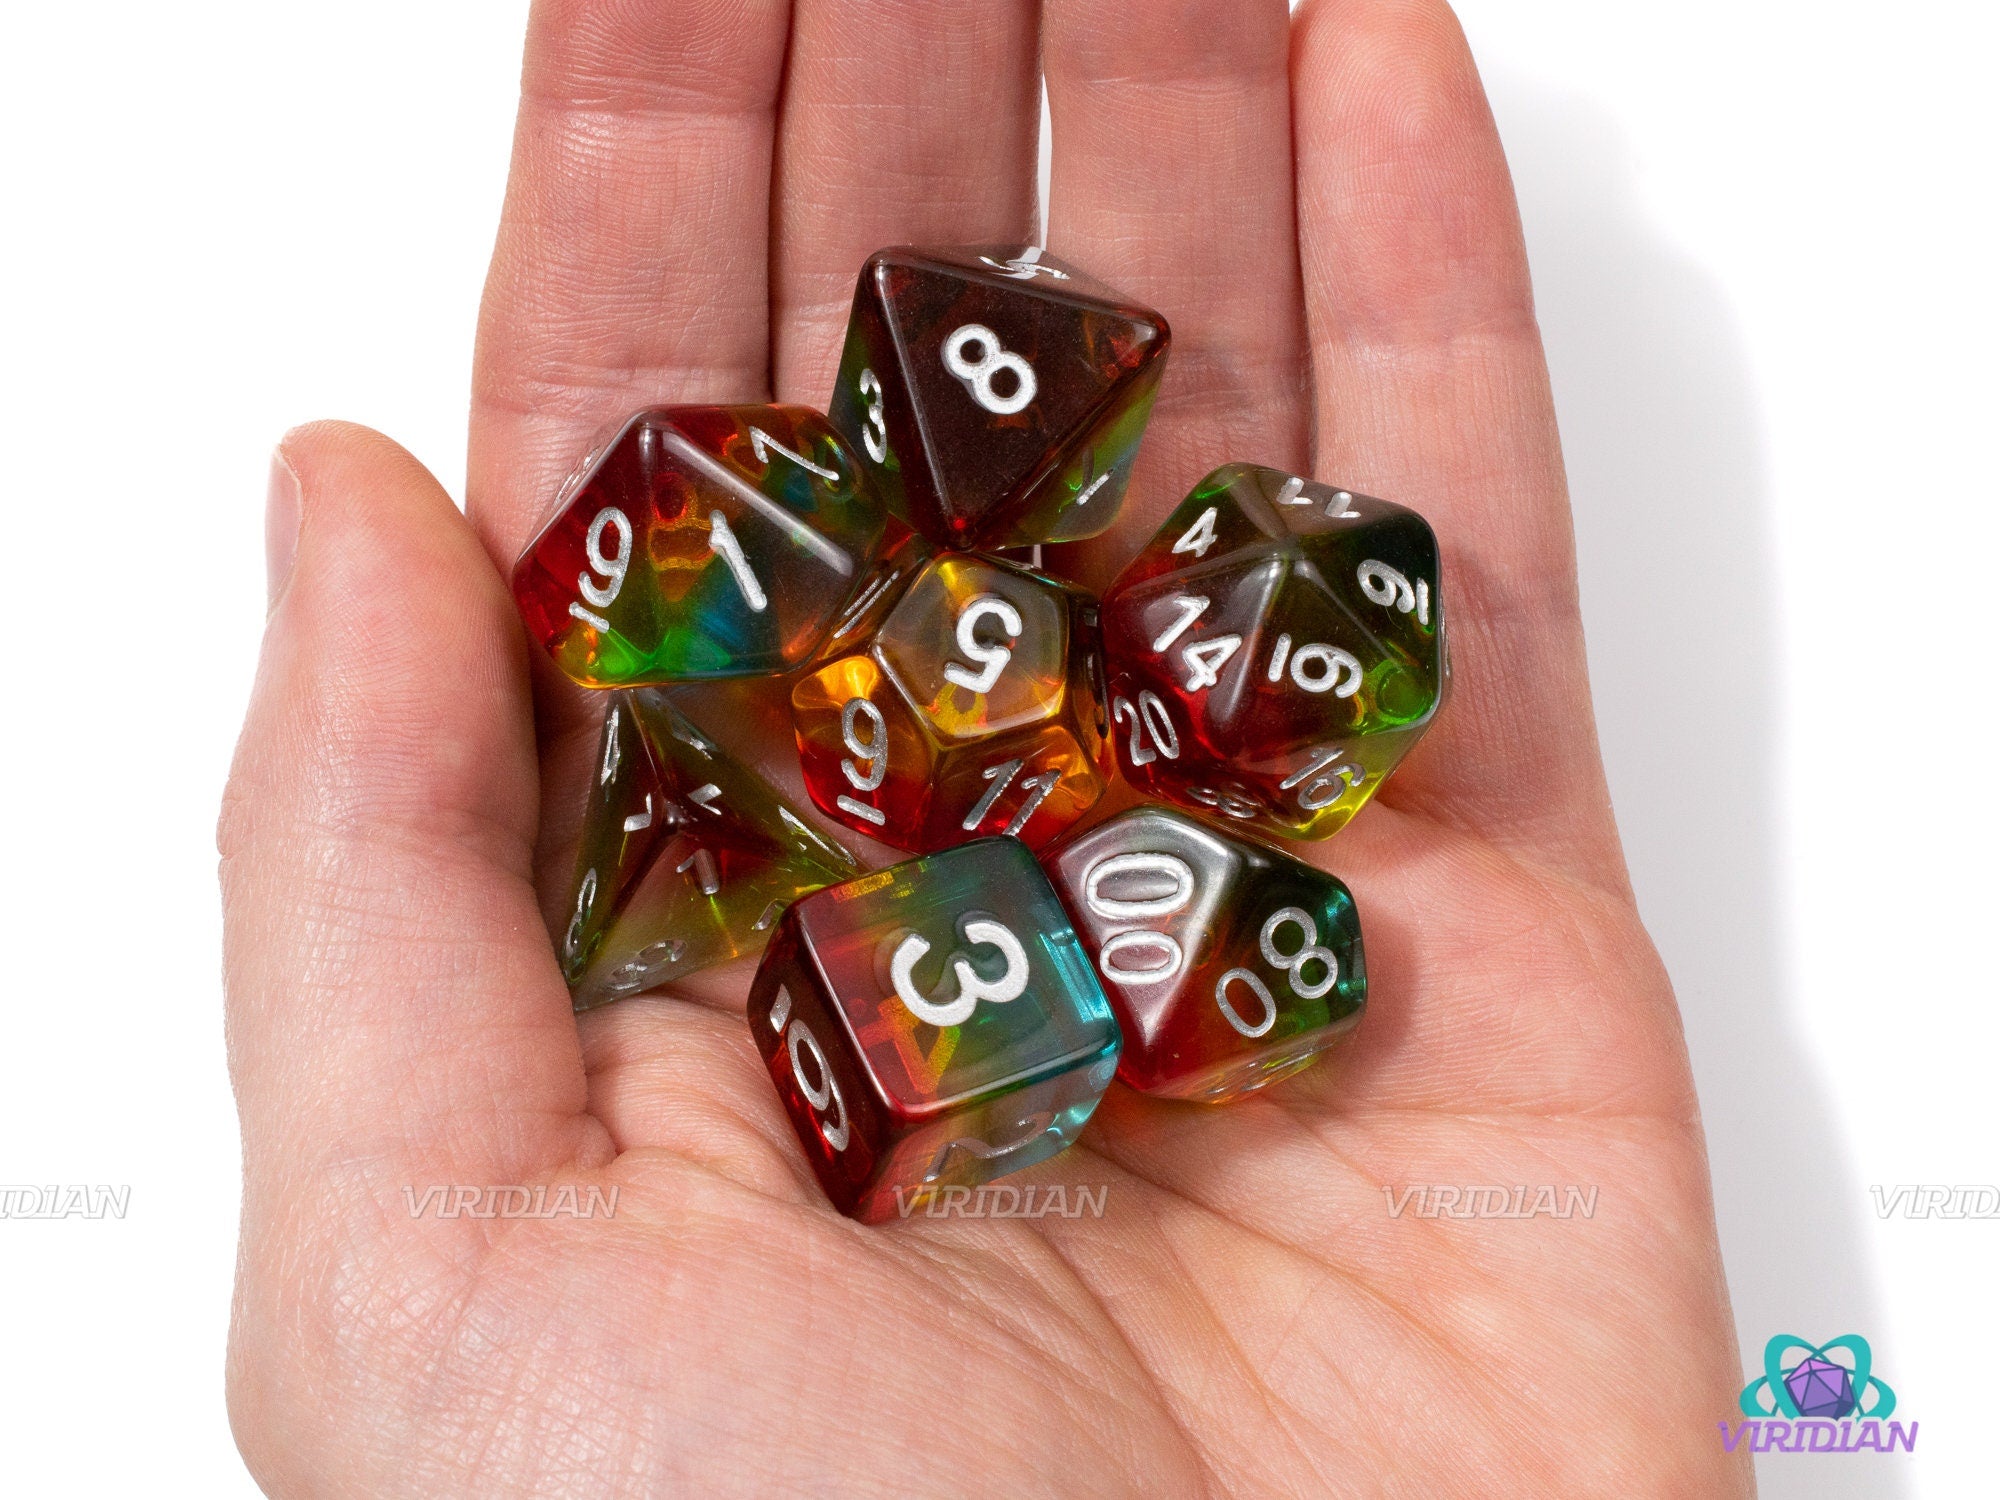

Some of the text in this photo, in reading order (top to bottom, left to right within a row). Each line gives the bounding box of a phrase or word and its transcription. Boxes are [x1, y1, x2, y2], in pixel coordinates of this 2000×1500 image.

[859, 368, 886, 463] 3
[941, 324, 1037, 414] 8
[749, 425, 839, 481] 7
[569, 506, 632, 633] 9
[709, 509, 767, 612] 1
[1172, 507, 1217, 557] 4
[943, 596, 1022, 693] 5
[1153, 596, 1242, 692] 14
[837, 697, 888, 825] 9
[1114, 690, 1179, 766] 20
[963, 759, 1061, 835] 11
[1280, 747, 1366, 809] 16
[891, 919, 1029, 1027] 3
[1216, 907, 1338, 1037] 80
